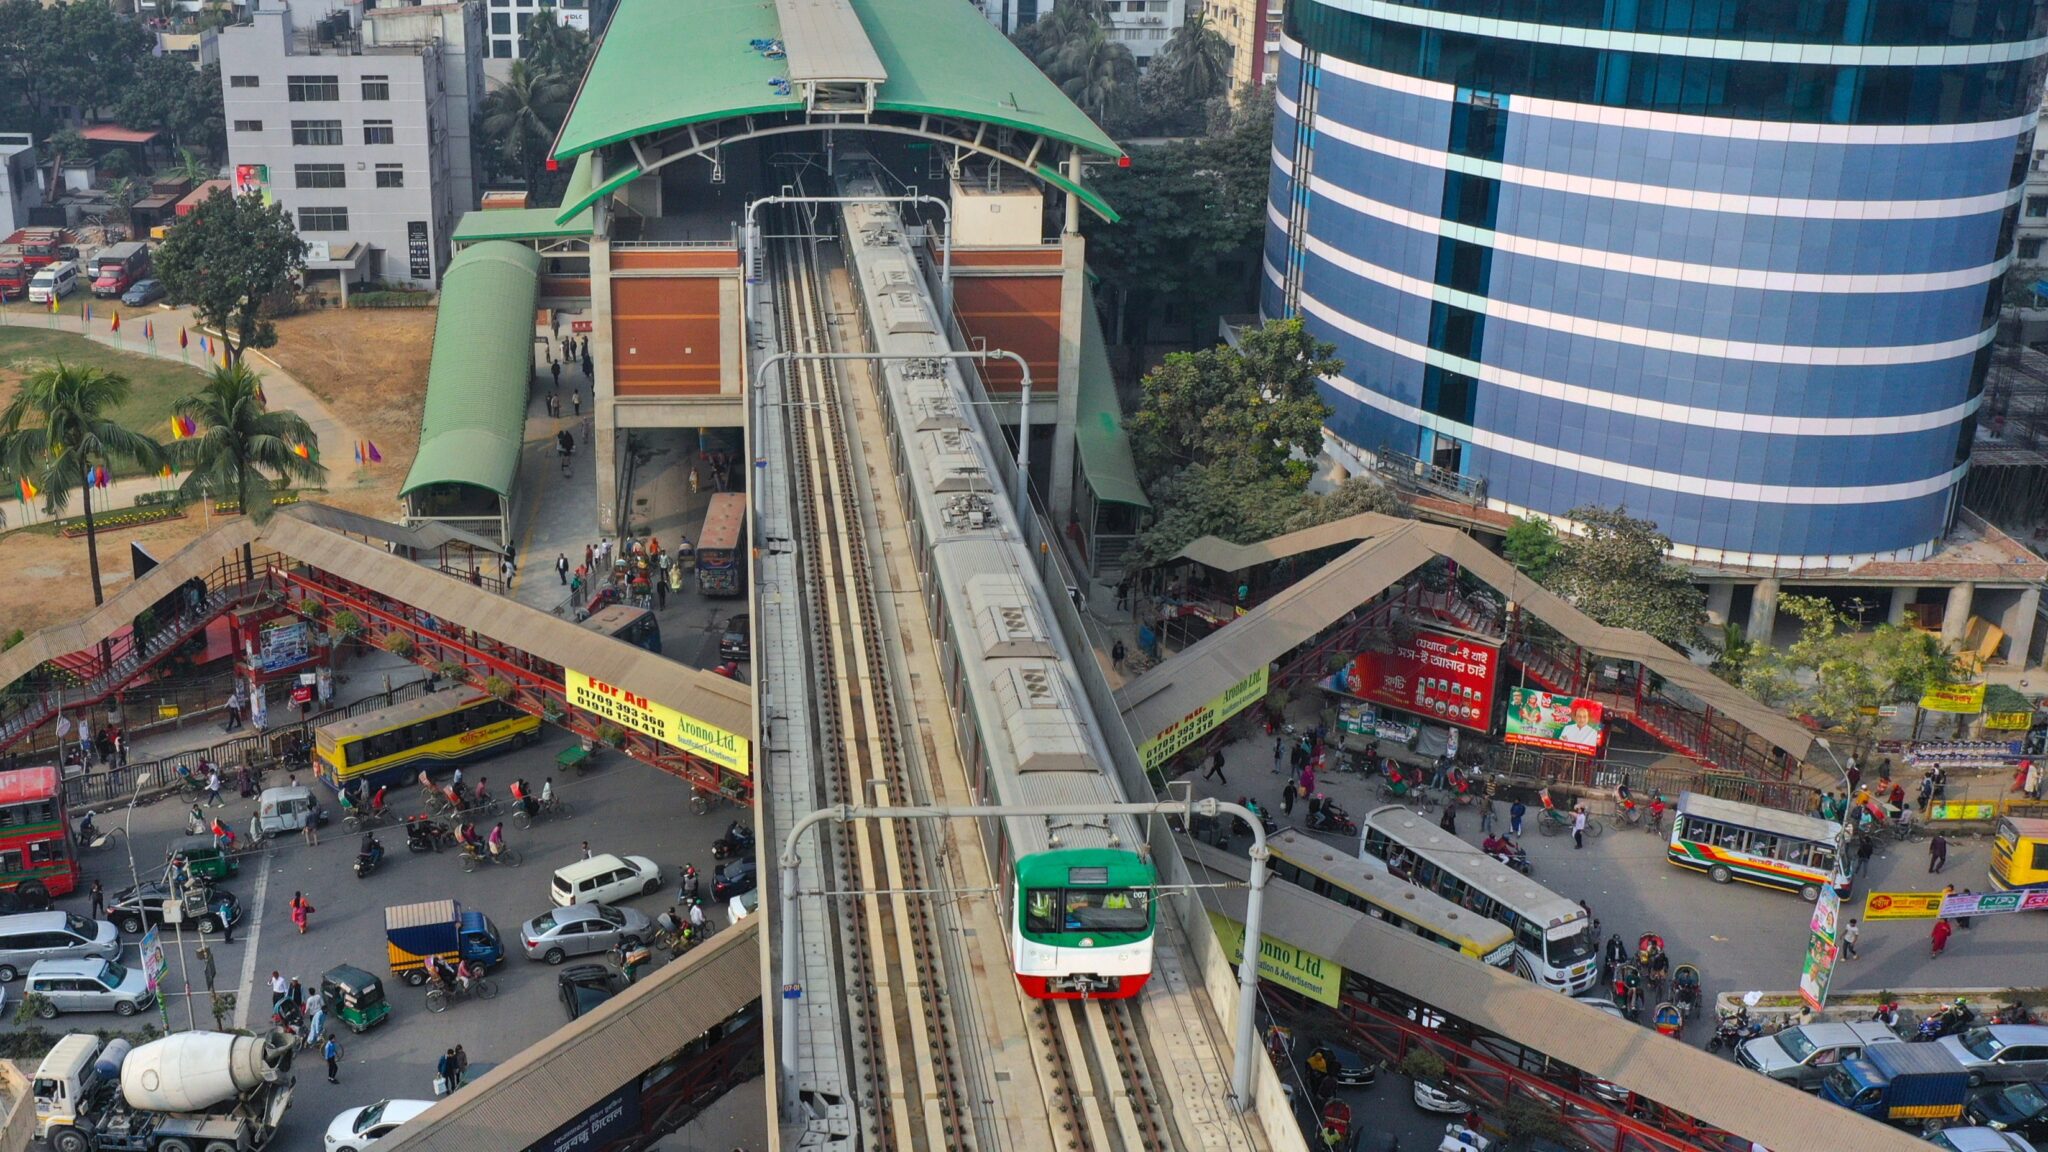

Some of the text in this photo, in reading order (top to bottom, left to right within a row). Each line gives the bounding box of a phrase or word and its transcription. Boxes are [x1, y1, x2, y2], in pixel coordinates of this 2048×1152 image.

[1430, 654, 1465, 673] আমার
[1467, 663, 1487, 679] চাই
[577, 686, 665, 729] 01709 393 360
[588, 676, 654, 713] For Ad.
[577, 695, 665, 738] 01918 130 418
[677, 715, 737, 753] Aronno Ltd.
[1146, 709, 1215, 759] 01709 393 360
[1177, 731, 1195, 748] 130
[1133, 891, 1147, 899] 007
[1237, 928, 1325, 980] Aonno Ltd.
[1274, 967, 1280, 975] &
[1280, 968, 1323, 995] Advertisement
